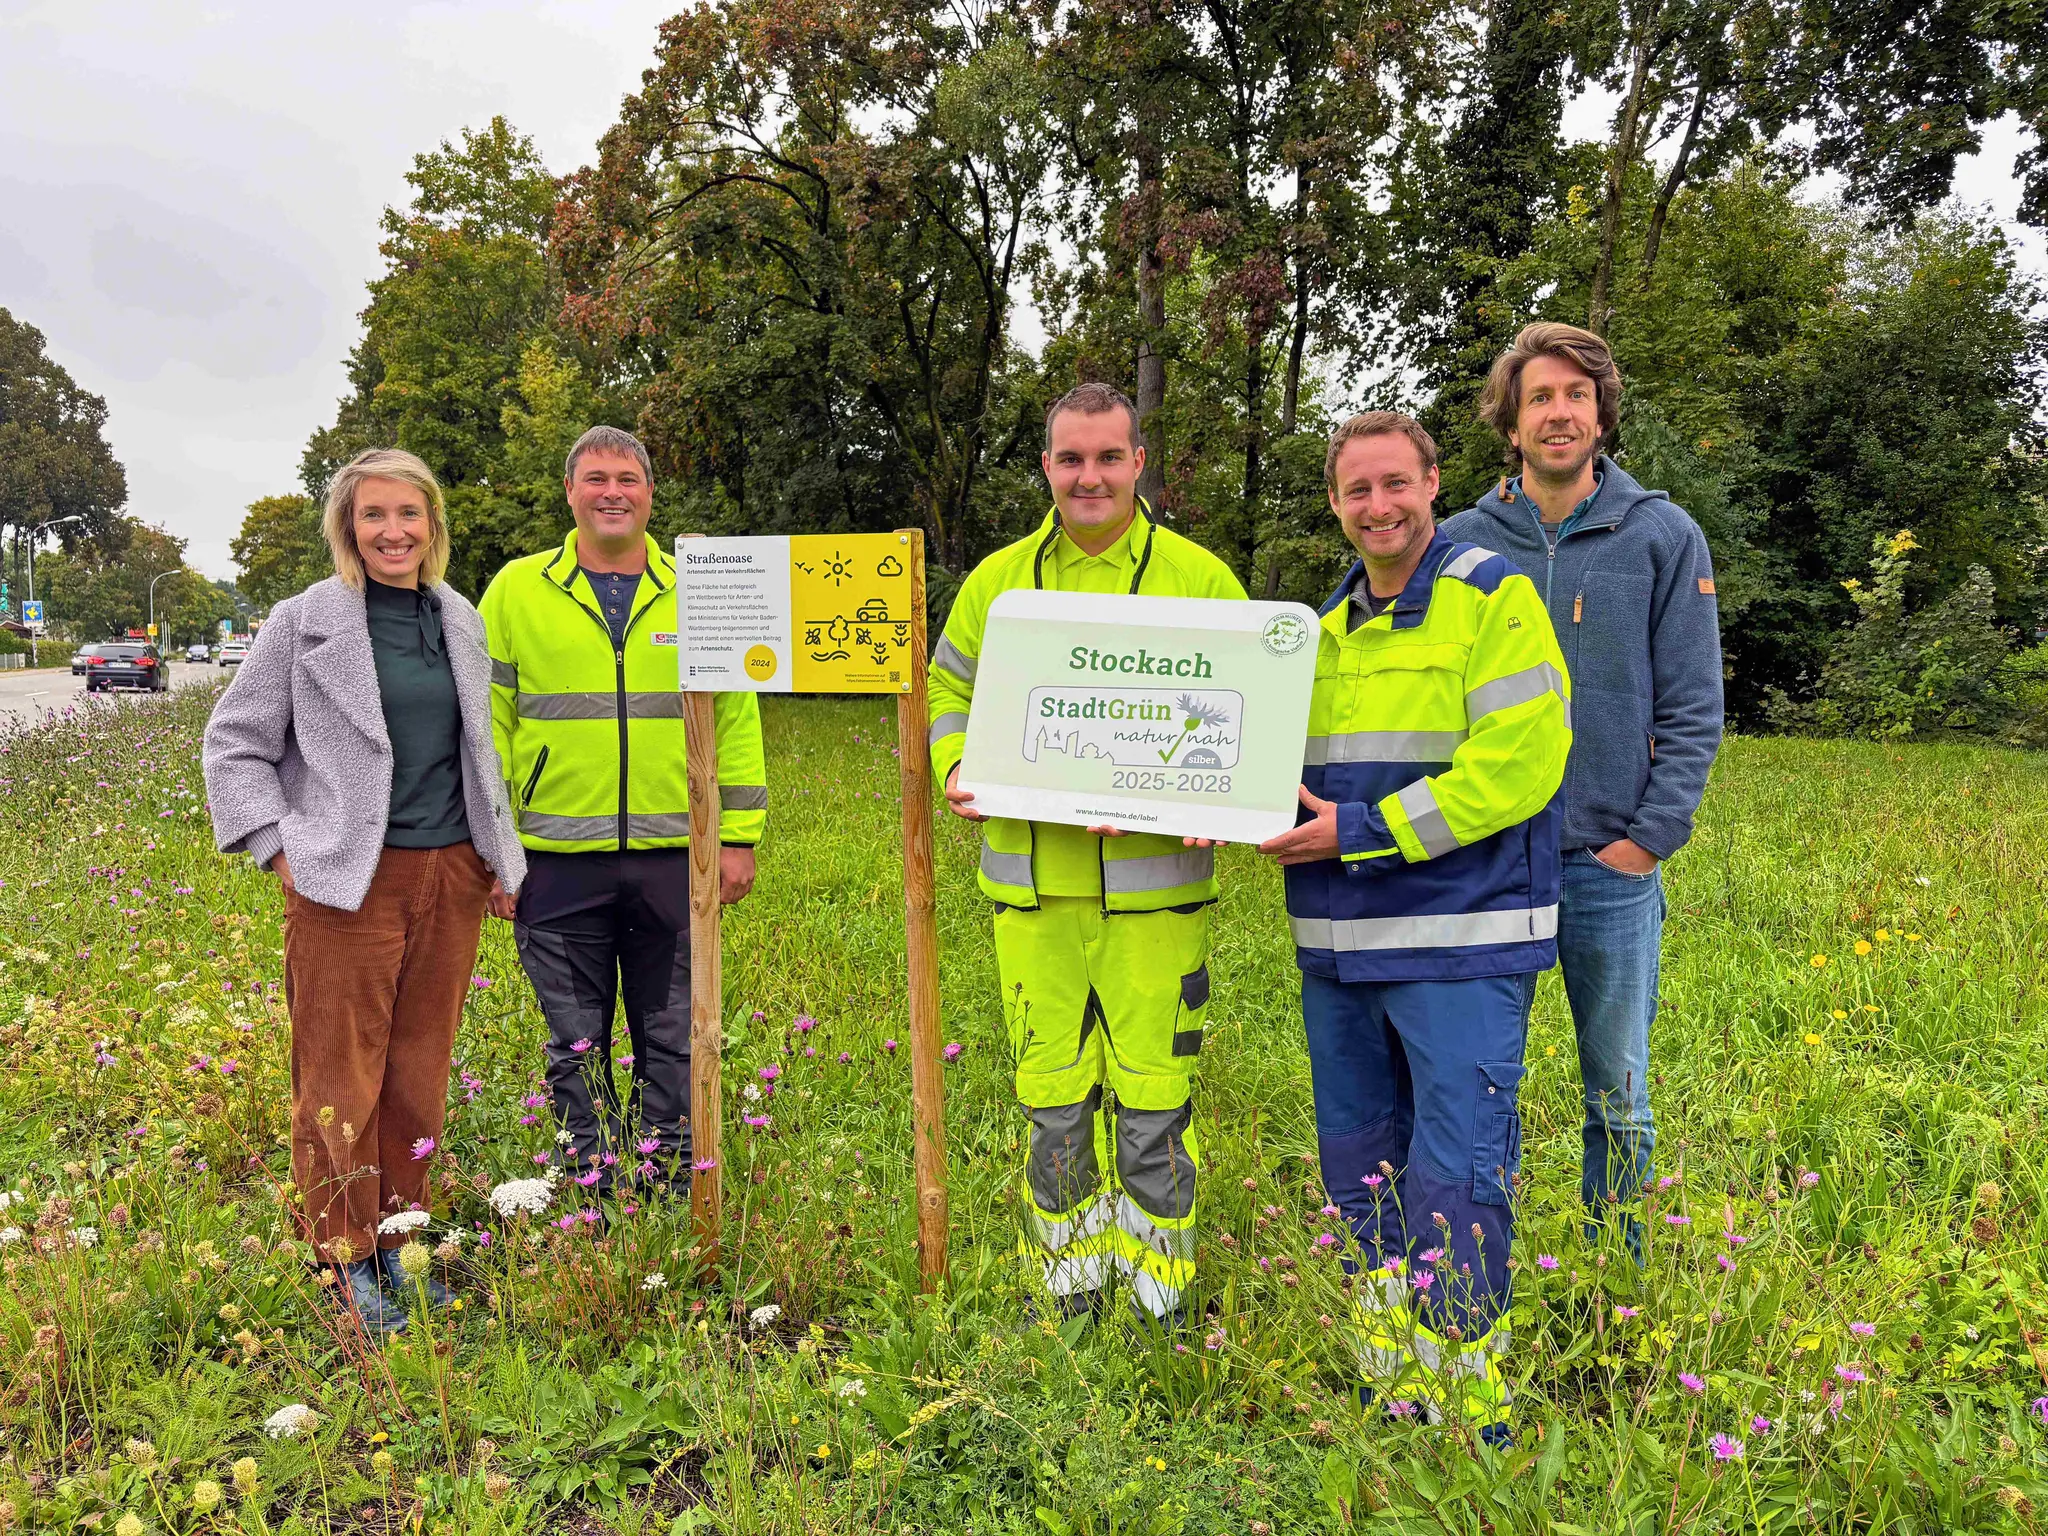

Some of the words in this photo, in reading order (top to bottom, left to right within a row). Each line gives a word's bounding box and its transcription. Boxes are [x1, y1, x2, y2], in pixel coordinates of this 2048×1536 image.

[686, 553, 752, 564] Straßenoase
[751, 659, 770, 667] 2024
[1069, 646, 1212, 678] Stockach
[1040, 697, 1172, 720] StadtGrün
[1114, 728, 1177, 744] natur
[1187, 731, 1236, 747] nah
[1188, 754, 1216, 764] silber
[1112, 771, 1232, 794] 2025-2028
[1075, 808, 1158, 822] www.kommbio.de/label
